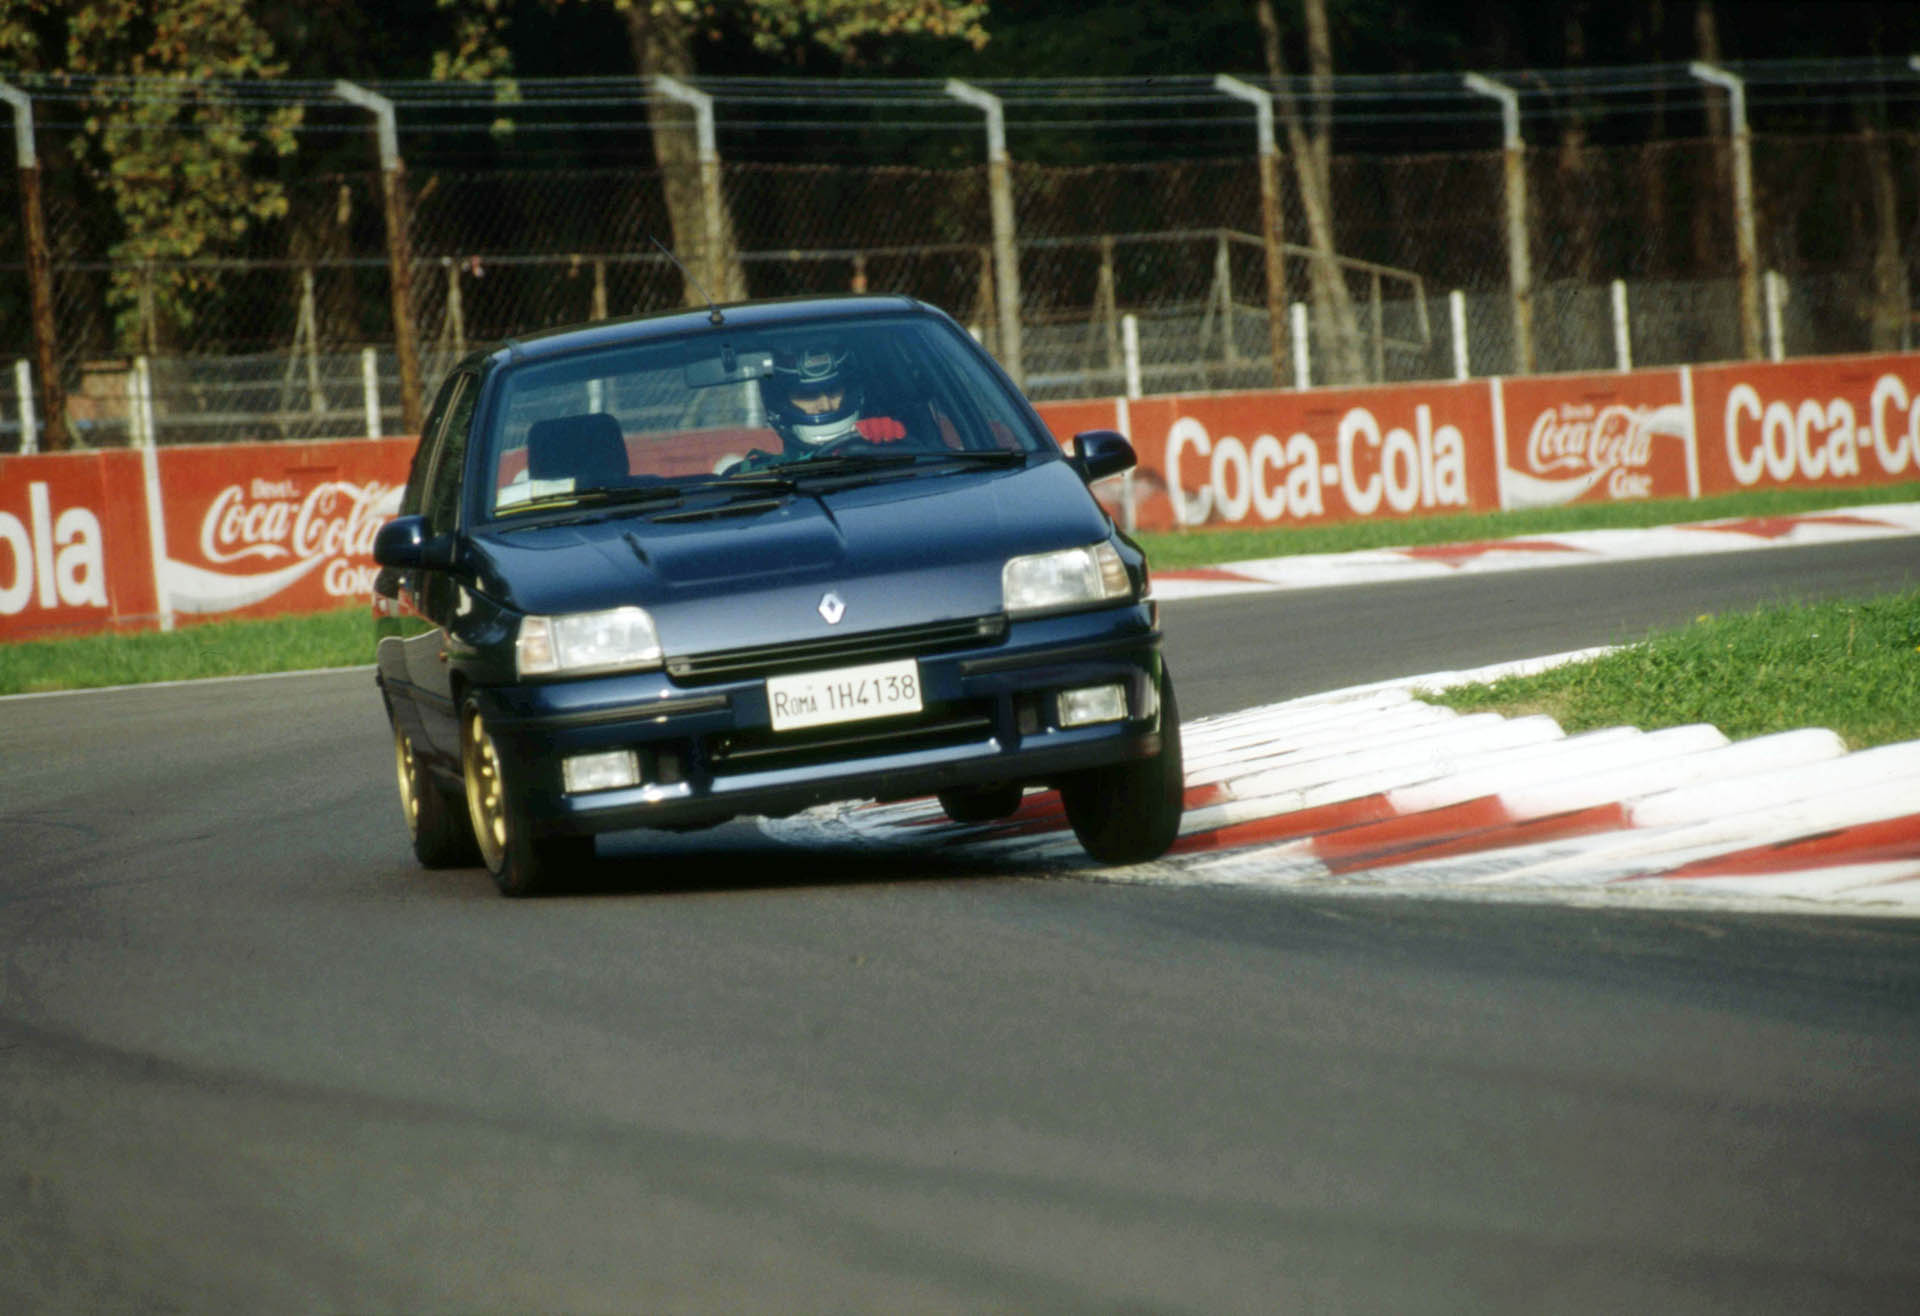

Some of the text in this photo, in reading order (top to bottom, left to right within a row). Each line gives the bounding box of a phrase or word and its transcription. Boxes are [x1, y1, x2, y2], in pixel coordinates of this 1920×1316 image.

[1165, 404, 1468, 526] Coca-Cola
[200, 481, 384, 563] Coca-Cola
[827, 674, 916, 711] 1H4138
